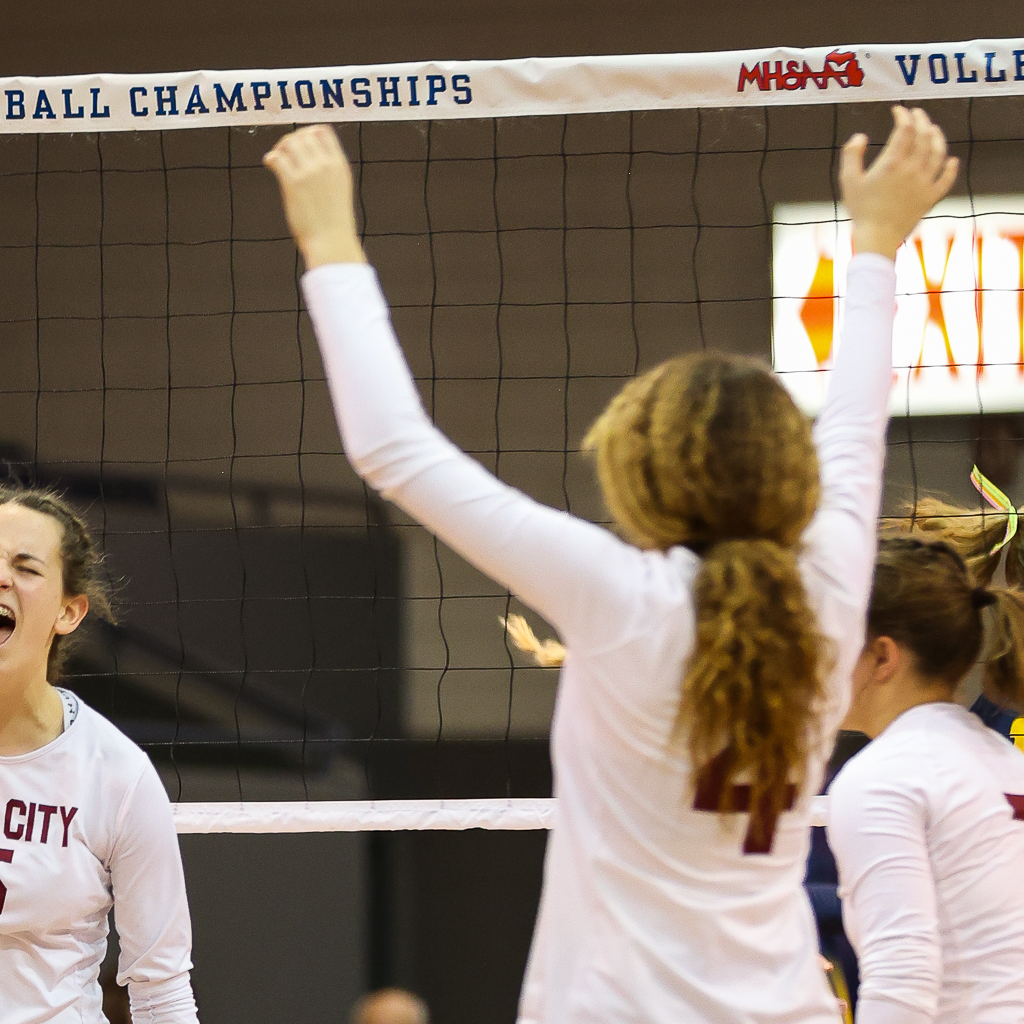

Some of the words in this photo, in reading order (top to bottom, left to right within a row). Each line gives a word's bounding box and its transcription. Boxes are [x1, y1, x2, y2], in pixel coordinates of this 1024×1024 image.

[129, 74, 473, 116] CHAMPIONSHIPS
[852, 228, 1024, 380] XIT
[3, 798, 79, 848] CITY
